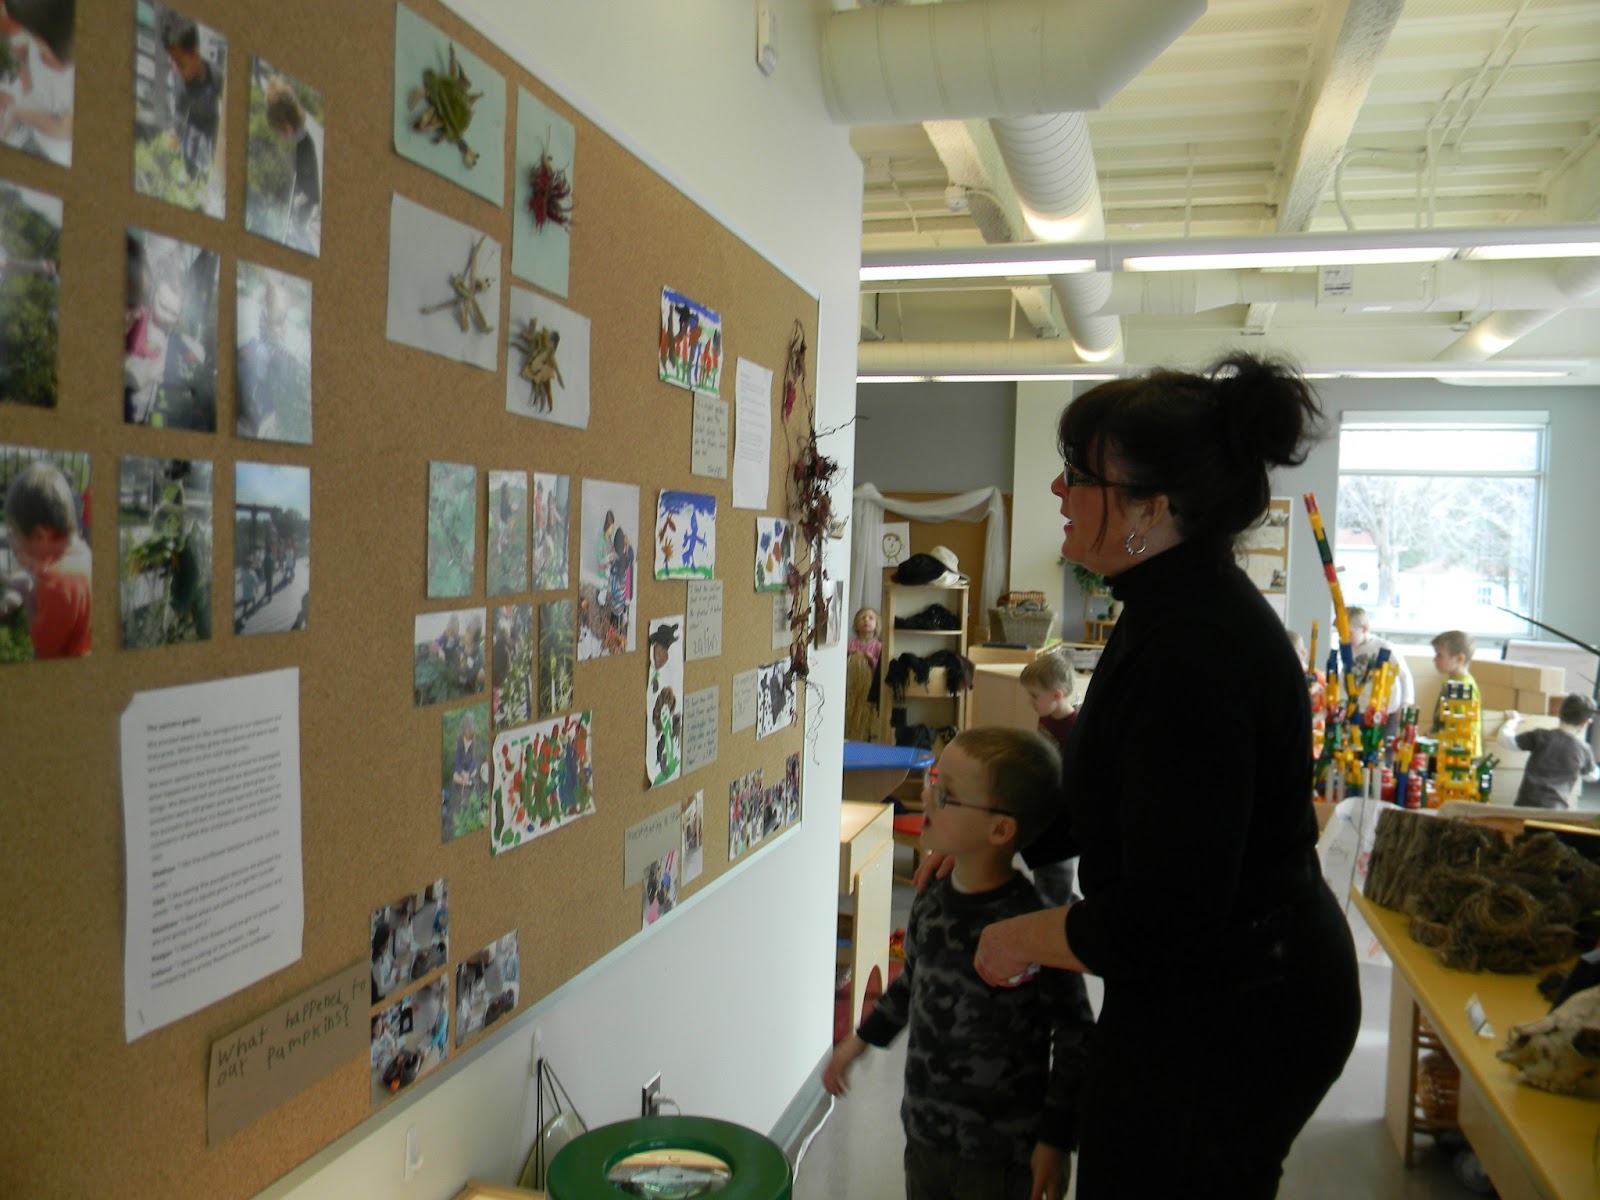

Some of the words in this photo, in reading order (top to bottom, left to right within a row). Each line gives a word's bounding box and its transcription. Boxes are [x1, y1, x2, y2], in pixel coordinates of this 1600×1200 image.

[217, 1058, 247, 1088] our
[267, 1005, 349, 1071] pumpkins?
[218, 1026, 268, 1067] What
[285, 987, 342, 1029] happened
[352, 977, 366, 1000] to
